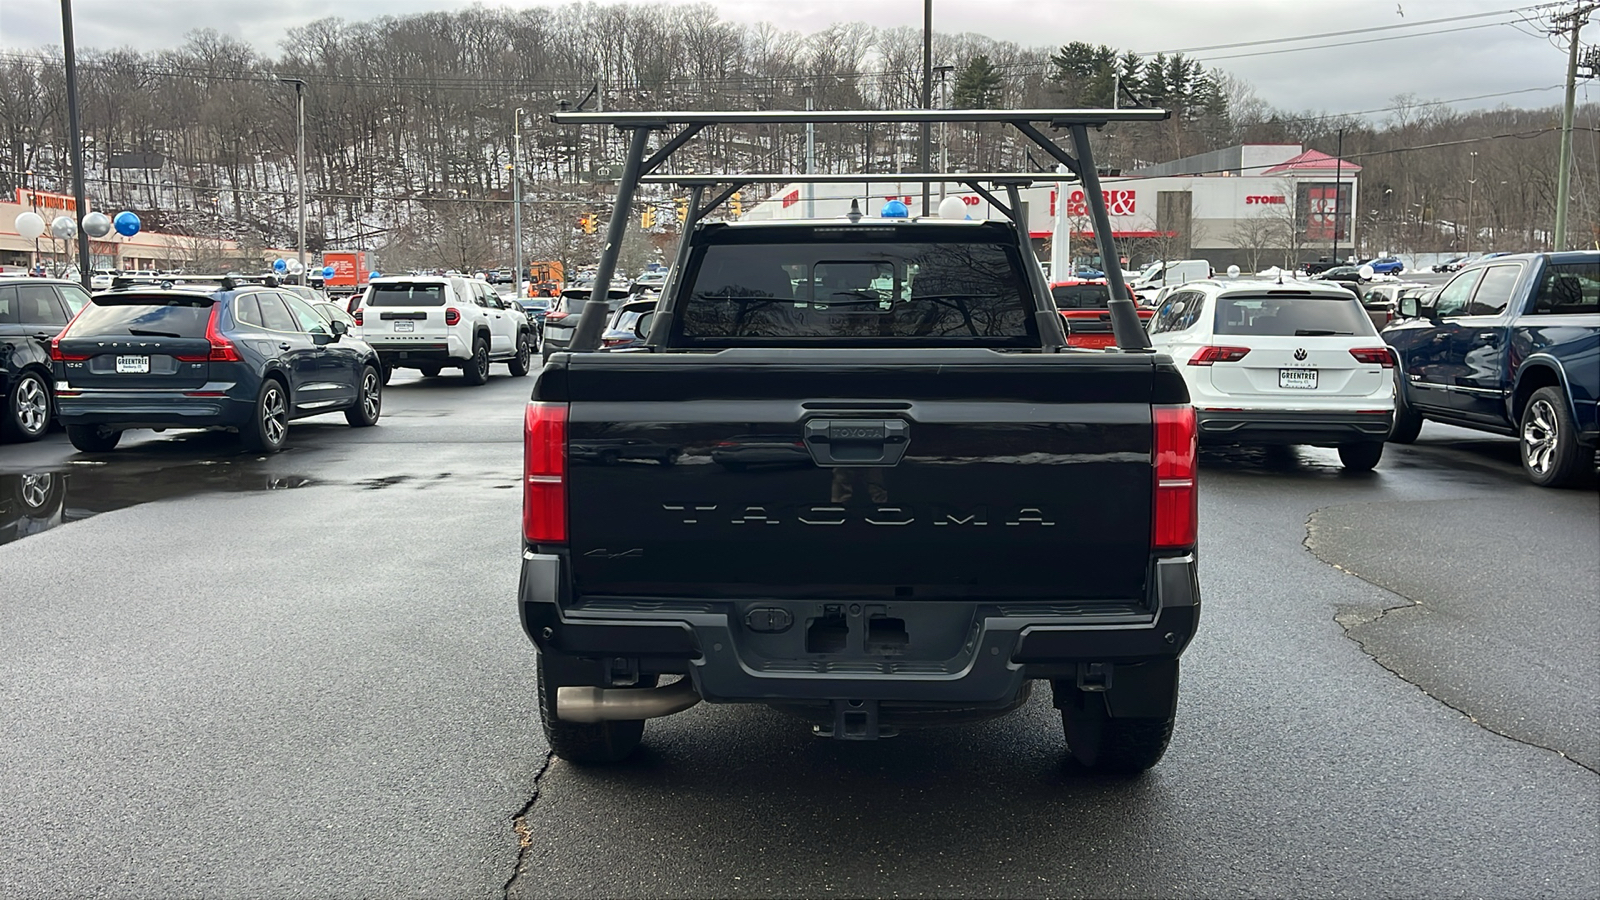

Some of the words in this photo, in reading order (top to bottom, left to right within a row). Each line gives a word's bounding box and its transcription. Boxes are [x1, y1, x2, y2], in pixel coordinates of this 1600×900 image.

[1246, 196, 1286, 204] STONE
[1281, 372, 1316, 380] GREENTREE
[832, 428, 884, 438] TOYOTA
[662, 503, 1056, 525] TACOMA
